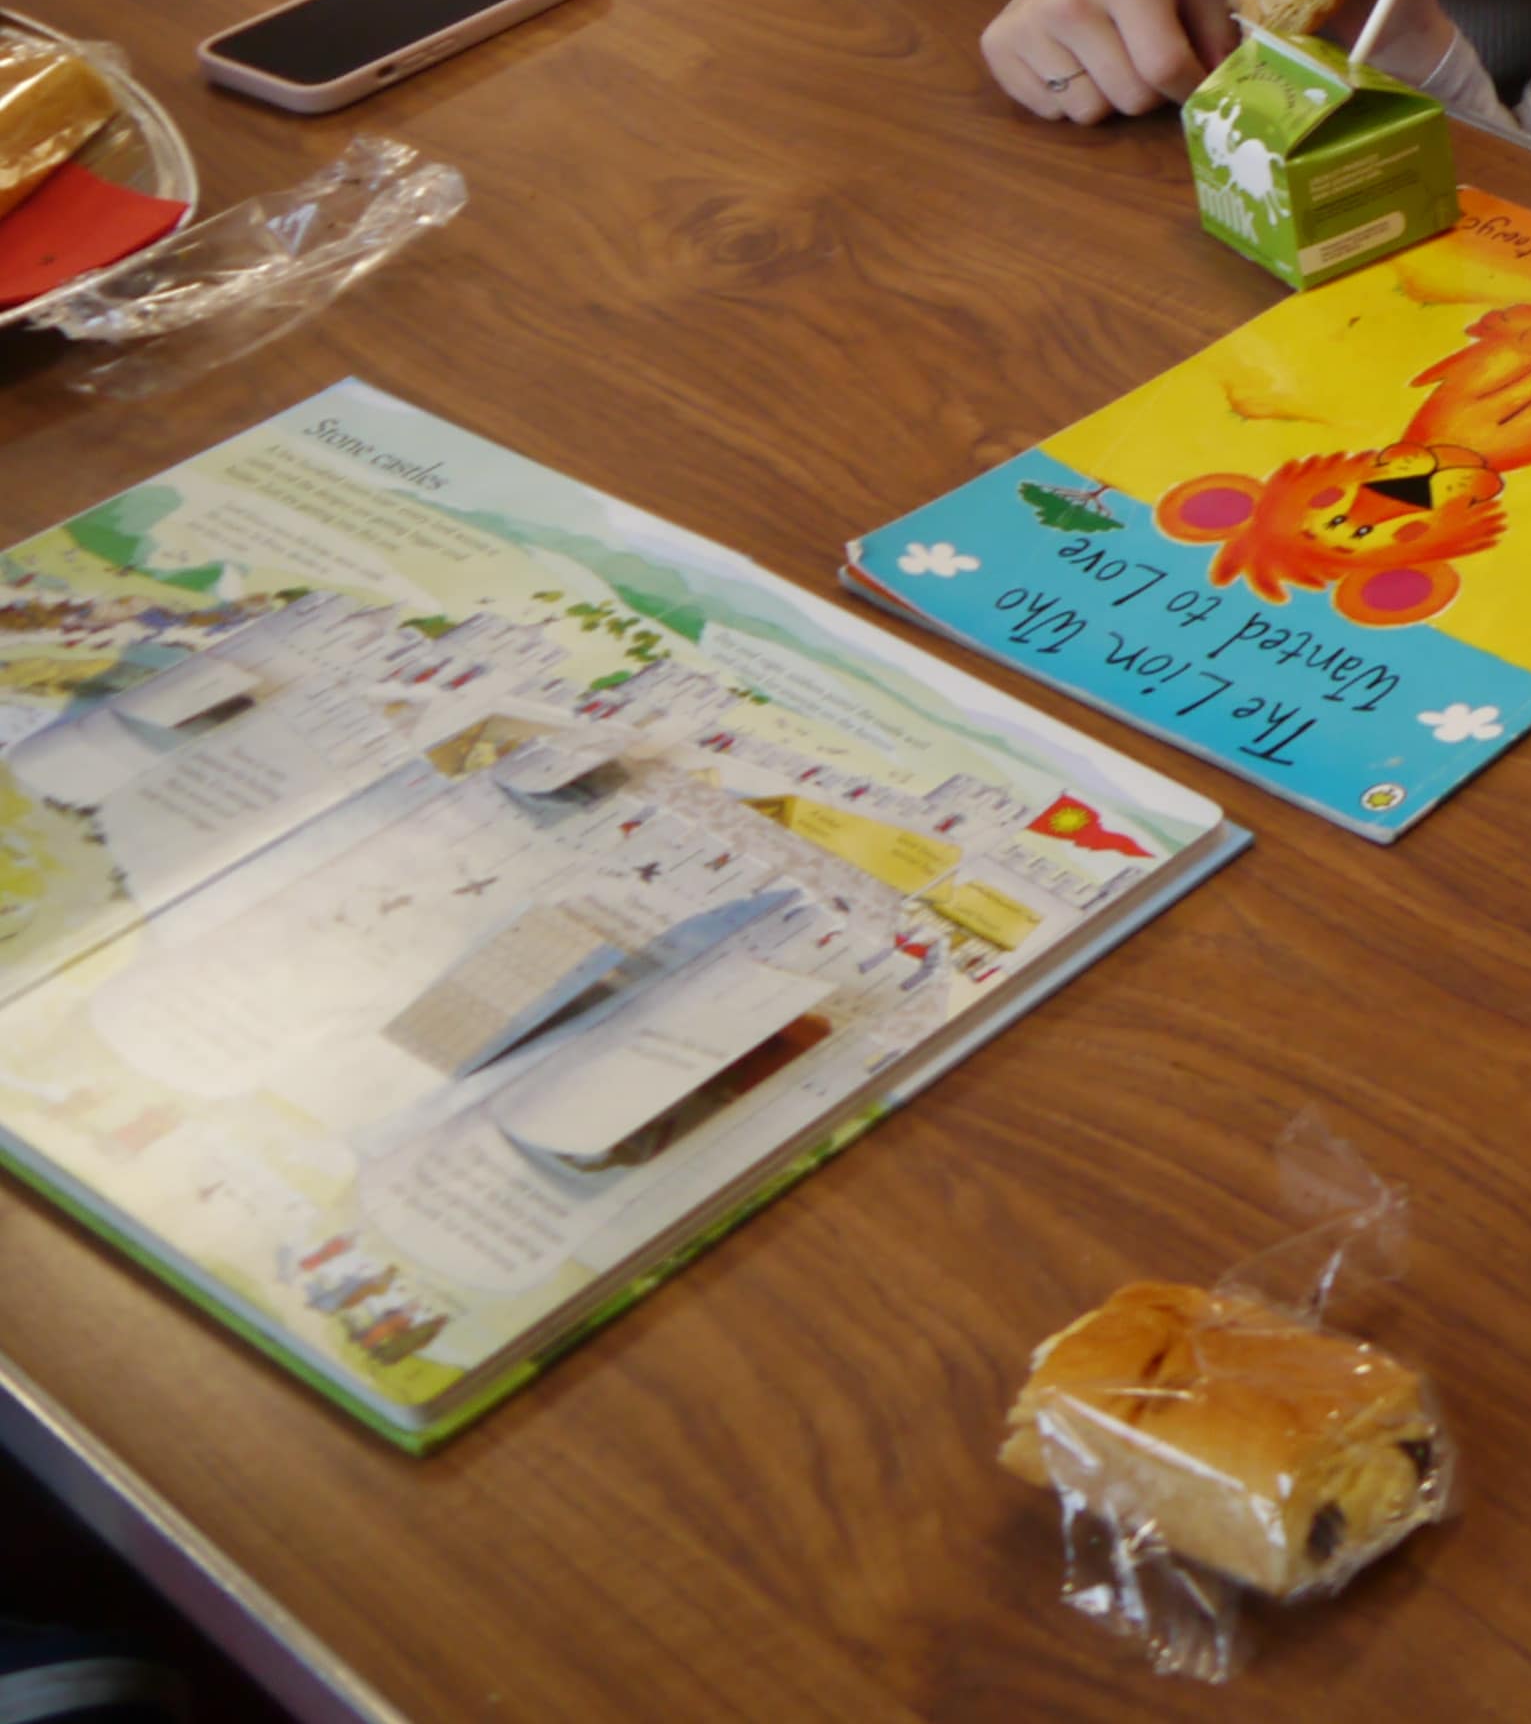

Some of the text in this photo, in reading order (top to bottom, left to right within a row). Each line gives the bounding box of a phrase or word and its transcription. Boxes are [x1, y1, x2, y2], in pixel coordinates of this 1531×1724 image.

[303, 418, 450, 491] Stone castles
[994, 586, 1318, 767] The Lion Who
[1056, 536, 1401, 713] Wanted to Love
